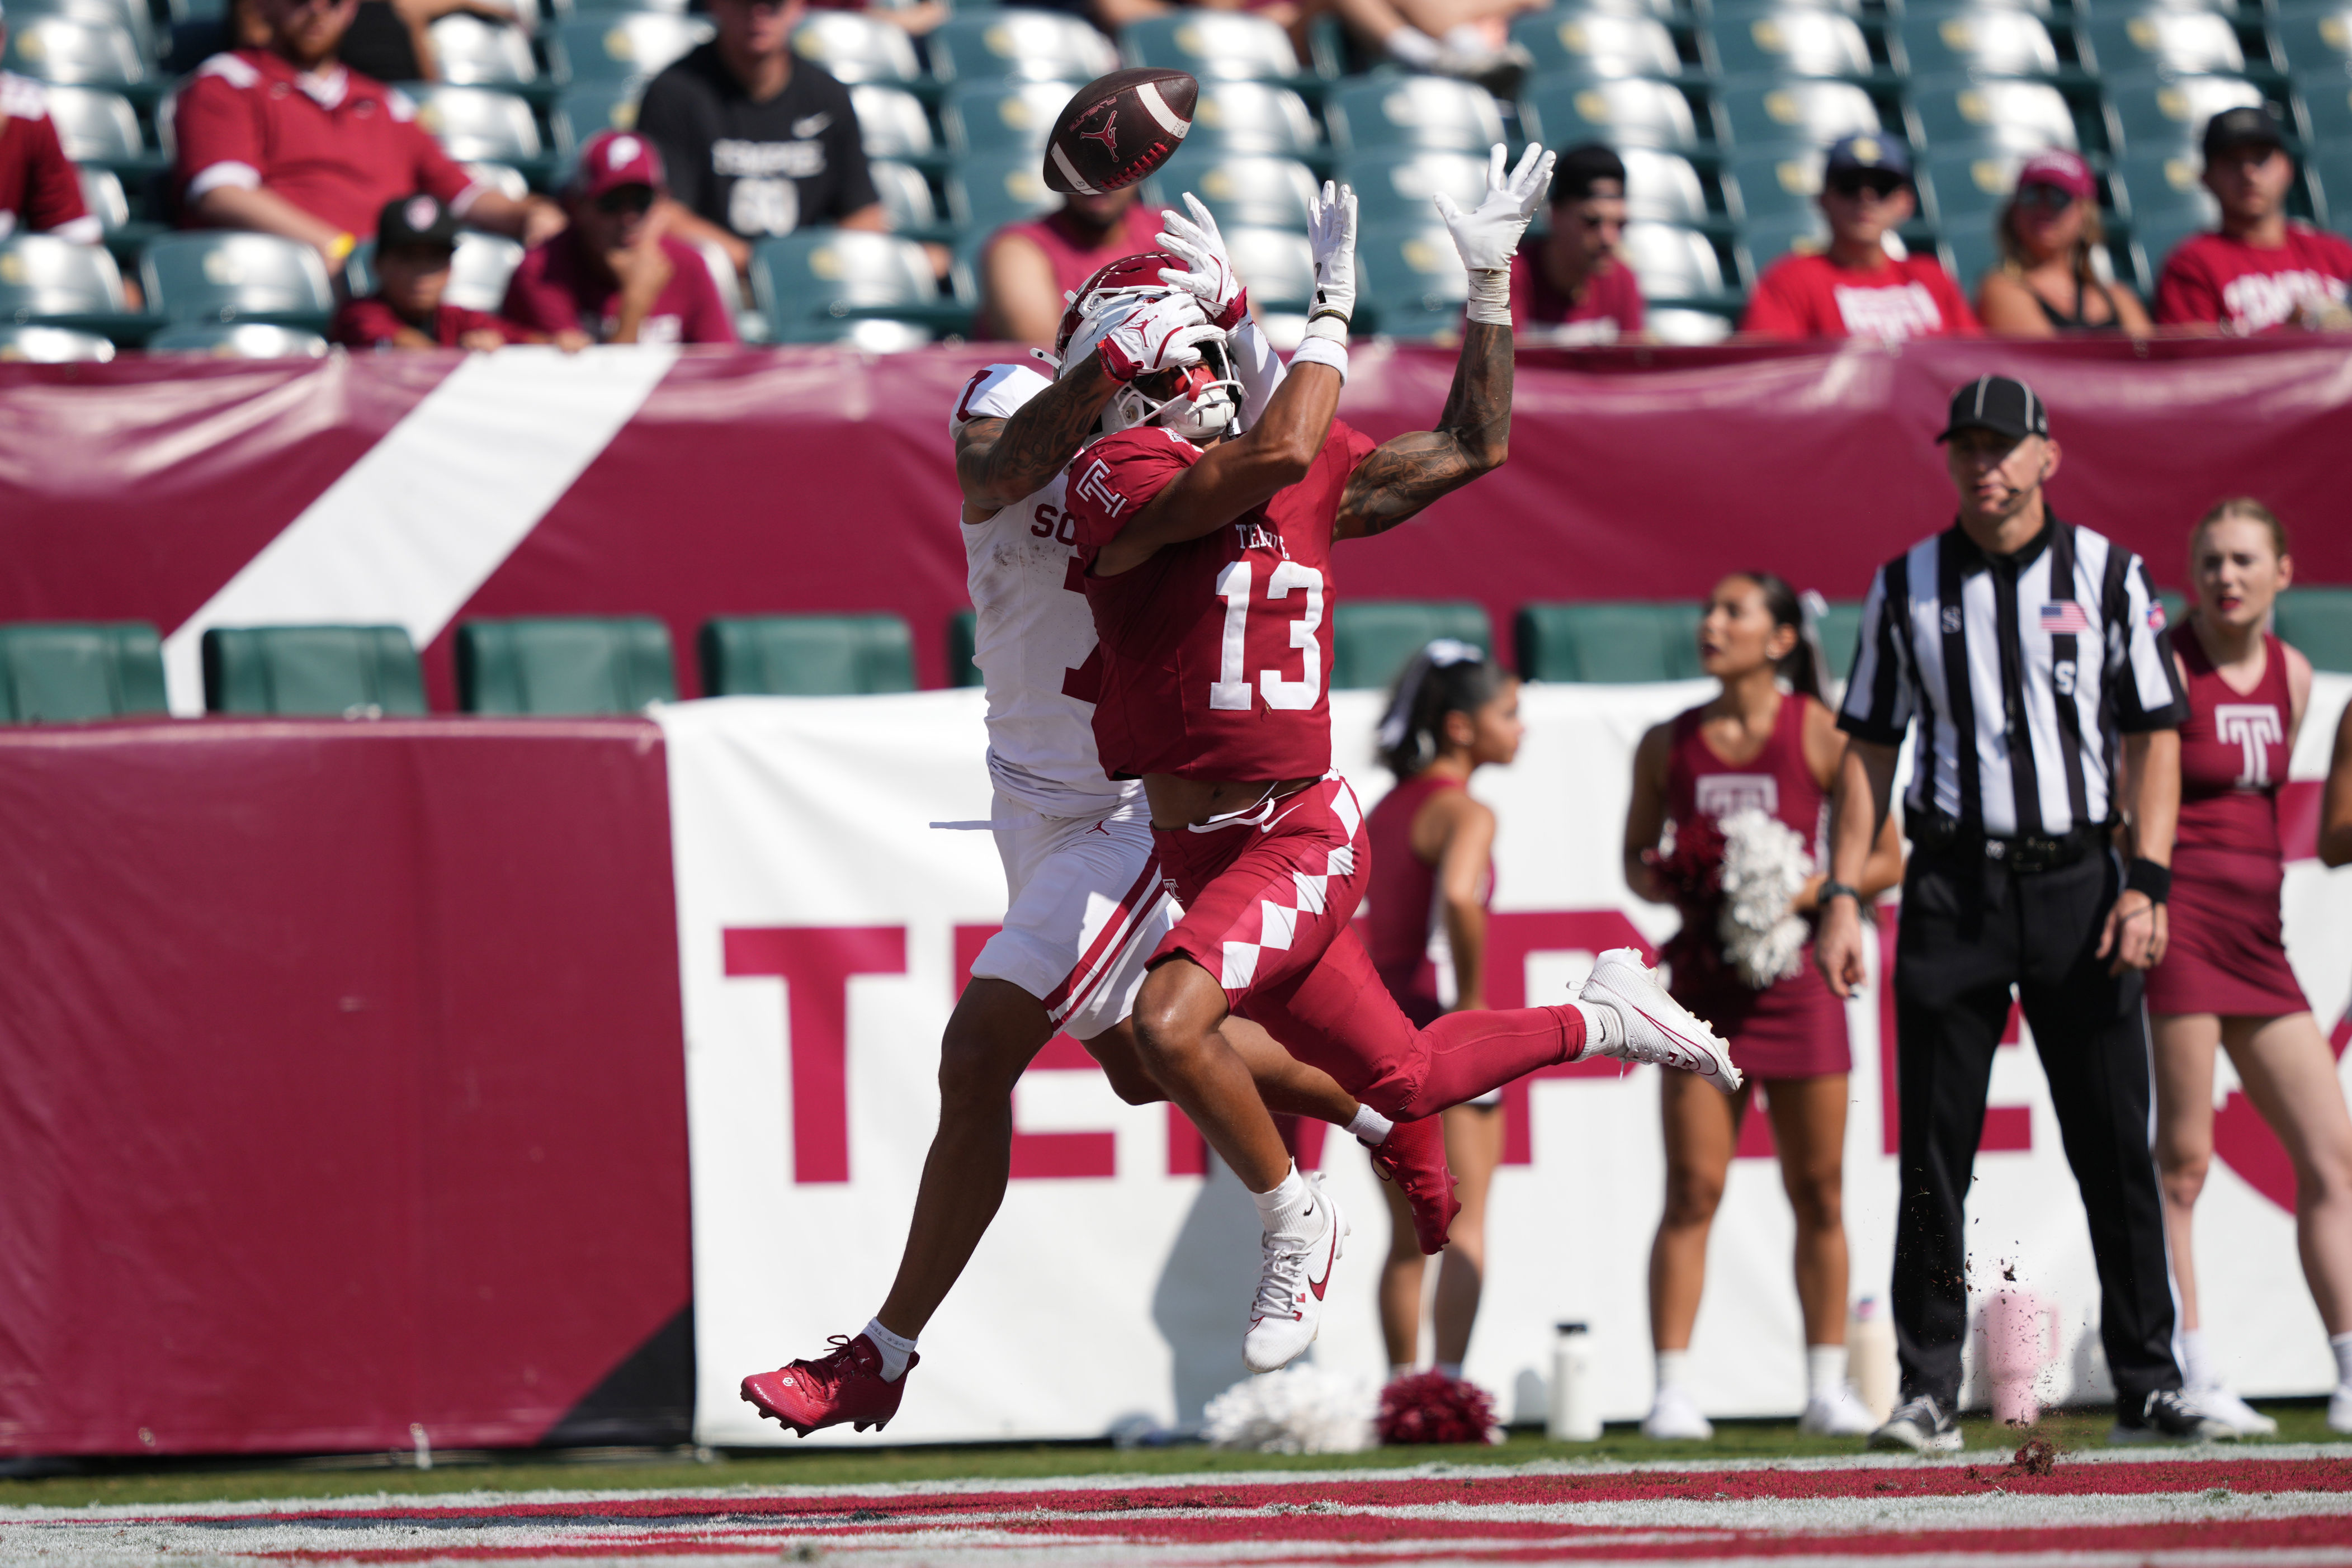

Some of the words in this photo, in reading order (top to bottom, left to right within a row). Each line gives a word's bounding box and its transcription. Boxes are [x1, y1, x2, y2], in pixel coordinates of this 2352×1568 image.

[1210, 560, 1324, 710] 13
[2055, 660, 2076, 696] S
[2214, 703, 2283, 792] T
